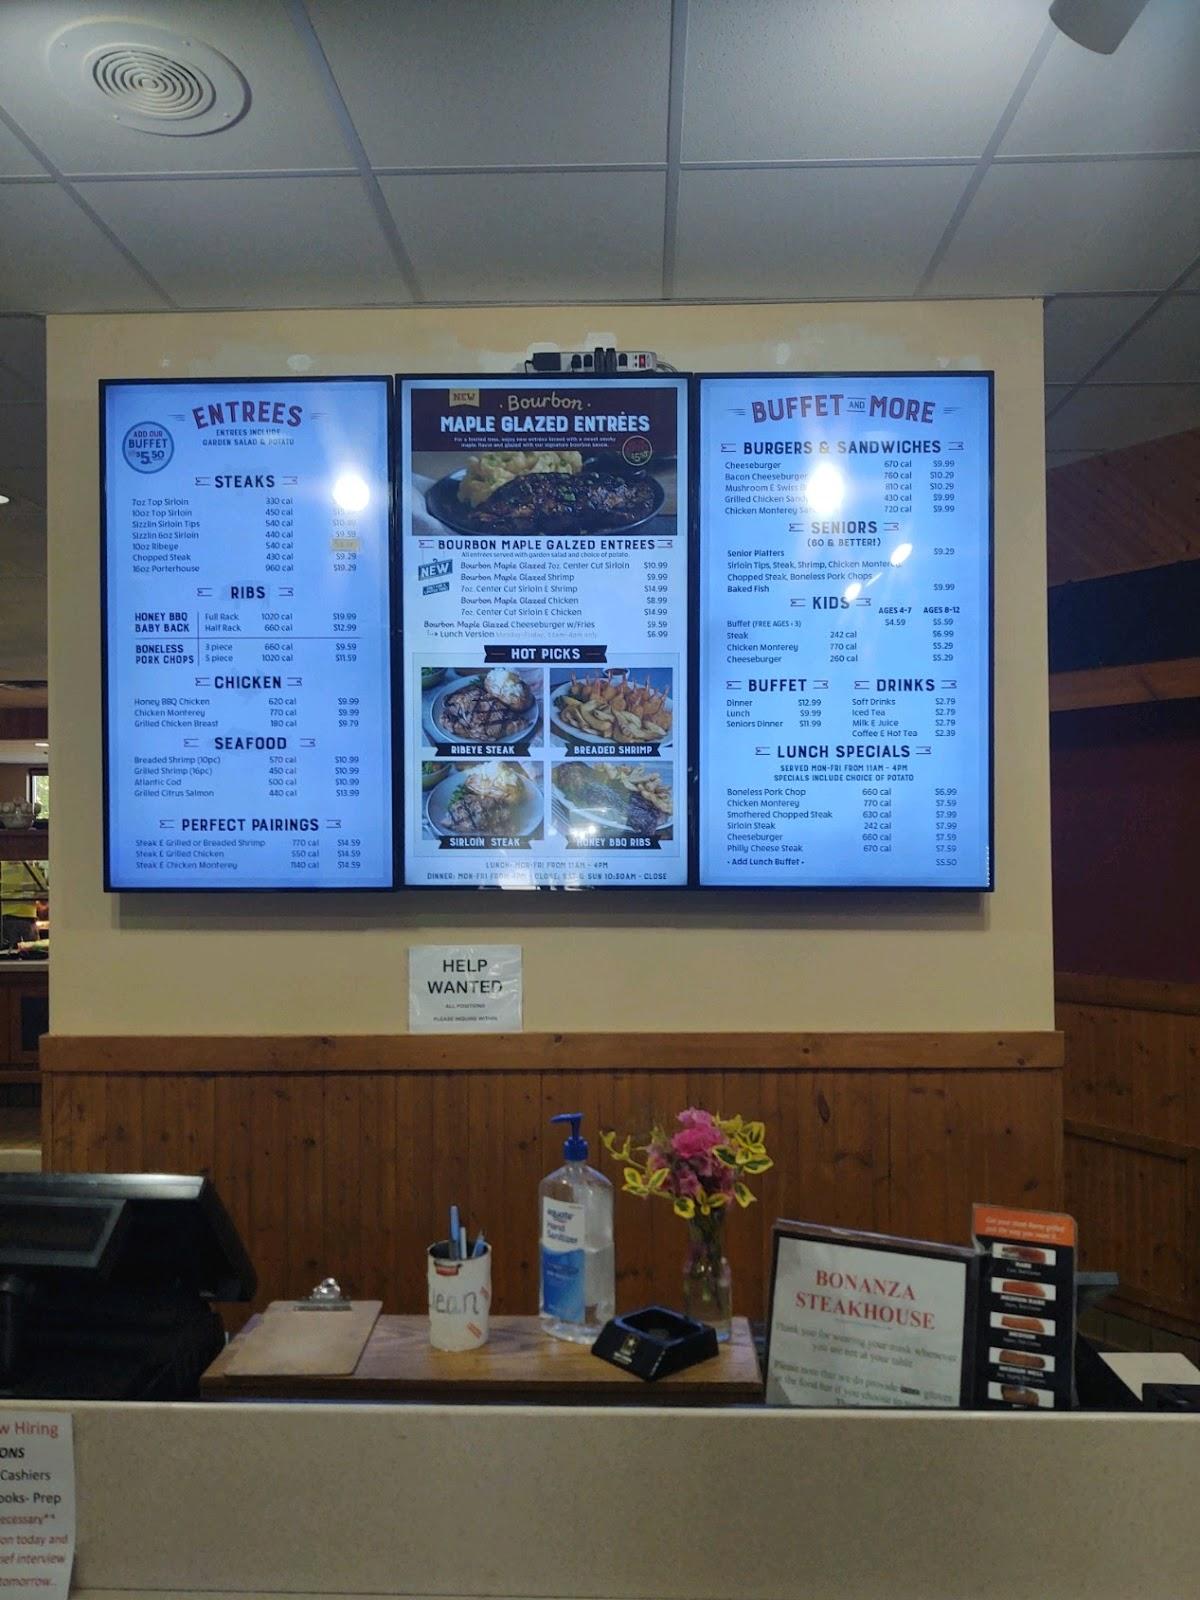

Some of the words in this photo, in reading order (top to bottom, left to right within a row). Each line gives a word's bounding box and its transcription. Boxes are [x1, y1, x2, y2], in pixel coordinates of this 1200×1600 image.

[453, 393, 475, 401] NEW
[508, 392, 584, 411] Bourbon
[752, 394, 844, 423] BUFFET
[849, 401, 865, 409] AND
[869, 396, 936, 424] MORE
[192, 400, 303, 429] ENTREES
[441, 416, 496, 432] MAPLE
[501, 416, 568, 432] GLAZED
[128, 439, 168, 449] BUFFET
[744, 441, 812, 455] BURGERS
[838, 440, 941, 454] SANDWICHES
[135, 450, 165, 465] $5.50
[725, 462, 781, 471] Cheeseburger
[725, 473, 751, 481] Bacon
[752, 473, 807, 481] Cheeseburger
[930, 471, 954, 480] $10.29
[215, 475, 275, 488] STEAKS
[147, 499, 163, 507] Top
[164, 498, 189, 506] Sirloin
[811, 521, 877, 534] SENIORS
[133, 543, 150, 551] 10oz
[152, 542, 179, 551] Ribeye
[438, 540, 496, 550] BOURBON
[502, 540, 541, 550] MAPLE
[546, 540, 595, 550] GALZED
[601, 540, 655, 550] ENTREES
[839, 537, 881, 547] BETTER!)
[132, 554, 168, 562] Chopped
[133, 565, 150, 573] 16oz
[334, 564, 357, 572] $19.29
[605, 561, 630, 569] Sirloin
[420, 563, 450, 578] NEW
[647, 573, 668, 581] $9.99
[231, 586, 265, 599] RIBS
[812, 597, 850, 609] KIDS
[944, 606, 960, 614] 8-12
[135, 612, 166, 621] HONEY
[169, 612, 188, 622] BBQ
[205, 613, 219, 621] Full
[220, 613, 239, 621] Rack
[333, 613, 357, 621] $19.99
[135, 624, 160, 633] BABY
[164, 623, 190, 632] BACK
[333, 624, 357, 632] $12.99
[511, 621, 565, 630] Cheeseburger
[567, 621, 595, 629] w/Fries
[440, 630, 463, 638] Lunch
[464, 630, 495, 638] Version
[932, 630, 954, 638] $6.99
[136, 644, 184, 654] BONELESS
[336, 643, 357, 651] $9.59
[336, 654, 357, 662] $11.59
[511, 648, 536, 659] HOT
[542, 648, 580, 659] PICKS
[136, 655, 159, 664] PORK
[163, 655, 194, 664] CHOPS
[215, 676, 281, 689] CHICKEN
[749, 679, 807, 692] BUFFET
[877, 679, 935, 692] DRINKS
[135, 698, 160, 707] Honey
[161, 698, 178, 707] BBQ
[338, 697, 360, 706] $9.99
[727, 699, 753, 707] Dinner
[798, 699, 822, 707] $12.99
[852, 698, 869, 706] Soft
[870, 698, 896, 706] Drinks
[135, 709, 166, 717] Chicken
[167, 709, 205, 717] Monterey
[338, 708, 360, 717] $9.99
[800, 709, 822, 717] $9.99
[135, 720, 160, 728] Grilled
[194, 720, 219, 728] Breast
[338, 719, 359, 727] $9.79
[215, 737, 287, 750] SEAFOOD
[451, 746, 483, 754] RIBEYE
[486, 745, 515, 754] STEAK
[574, 746, 615, 754] BREADED
[618, 746, 652, 754] SHRIMP
[778, 745, 828, 758] LUNCH
[836, 745, 910, 758] SPECIALS
[134, 756, 168, 764] Breaded
[168, 756, 196, 765] Shrimp
[197, 756, 221, 765] (10pc)
[335, 756, 359, 764] $10.99
[134, 778, 165, 786] Atlantic
[166, 778, 182, 786] Cod
[134, 789, 160, 797] Grilled
[161, 789, 184, 797] Citrus
[185, 789, 215, 797] Salmon
[727, 788, 762, 796] Boneless
[764, 788, 783, 796] Pork
[785, 788, 806, 797] Chop
[727, 810, 771, 818] Smothered
[772, 811, 809, 819] Chopped
[182, 819, 246, 831] PERFECT
[252, 818, 319, 831] PAIRINGS
[754, 822, 776, 830] Steak
[450, 837, 485, 846] SIRLOIN
[491, 838, 520, 846] STEAK
[609, 838, 627, 847] BBQ
[630, 838, 651, 846] RIBS
[775, 858, 802, 866] Buffet
[443, 959, 488, 972] HELP
[428, 980, 503, 994] WANTED
[816, 1270, 915, 1301] BONANZA
[795, 1292, 935, 1330] STEAKHOUSE
[15, 1421, 59, 1438] Hiring
[0, 1469, 51, 1481] Cashiers
[33, 1492, 61, 1506] Prep
[16, 1535, 46, 1549] today
[49, 1534, 68, 1544] and
[17, 1554, 65, 1564] interview
